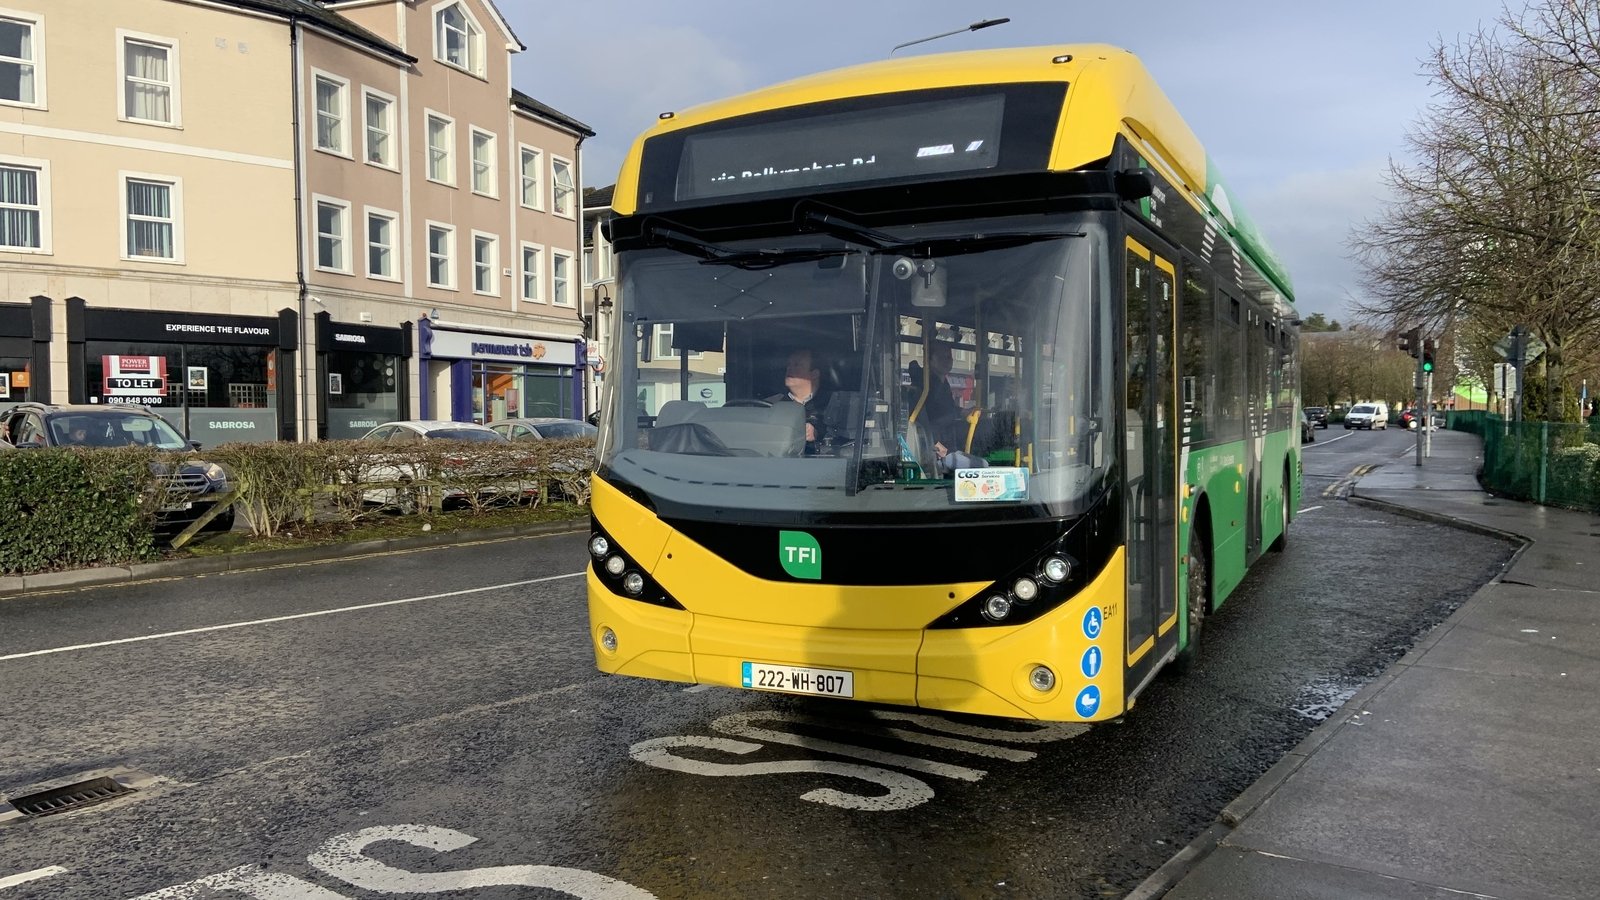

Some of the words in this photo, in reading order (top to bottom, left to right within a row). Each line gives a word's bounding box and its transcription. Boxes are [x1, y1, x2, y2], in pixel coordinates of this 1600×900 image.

[166, 324, 216, 334] EXPERIENCE
[216, 325, 233, 335] THE
[234, 326, 270, 336] FLAVOUR
[335, 333, 366, 343] SABROSA
[471, 341, 517, 356] permanent
[518, 342, 533, 357] tsb
[115, 379, 132, 388] TO
[134, 379, 156, 388] LET
[108, 396, 123, 404] 090
[125, 396, 141, 404] 648
[142, 396, 163, 404] 9000
[208, 420, 256, 430] SABROSA
[349, 420, 378, 428] SABROSA
[957, 470, 980, 479] CGS
[785, 547, 816, 564] TFI
[1104, 603, 1118, 620] EA11
[759, 670, 844, 693] 222-WH-807
